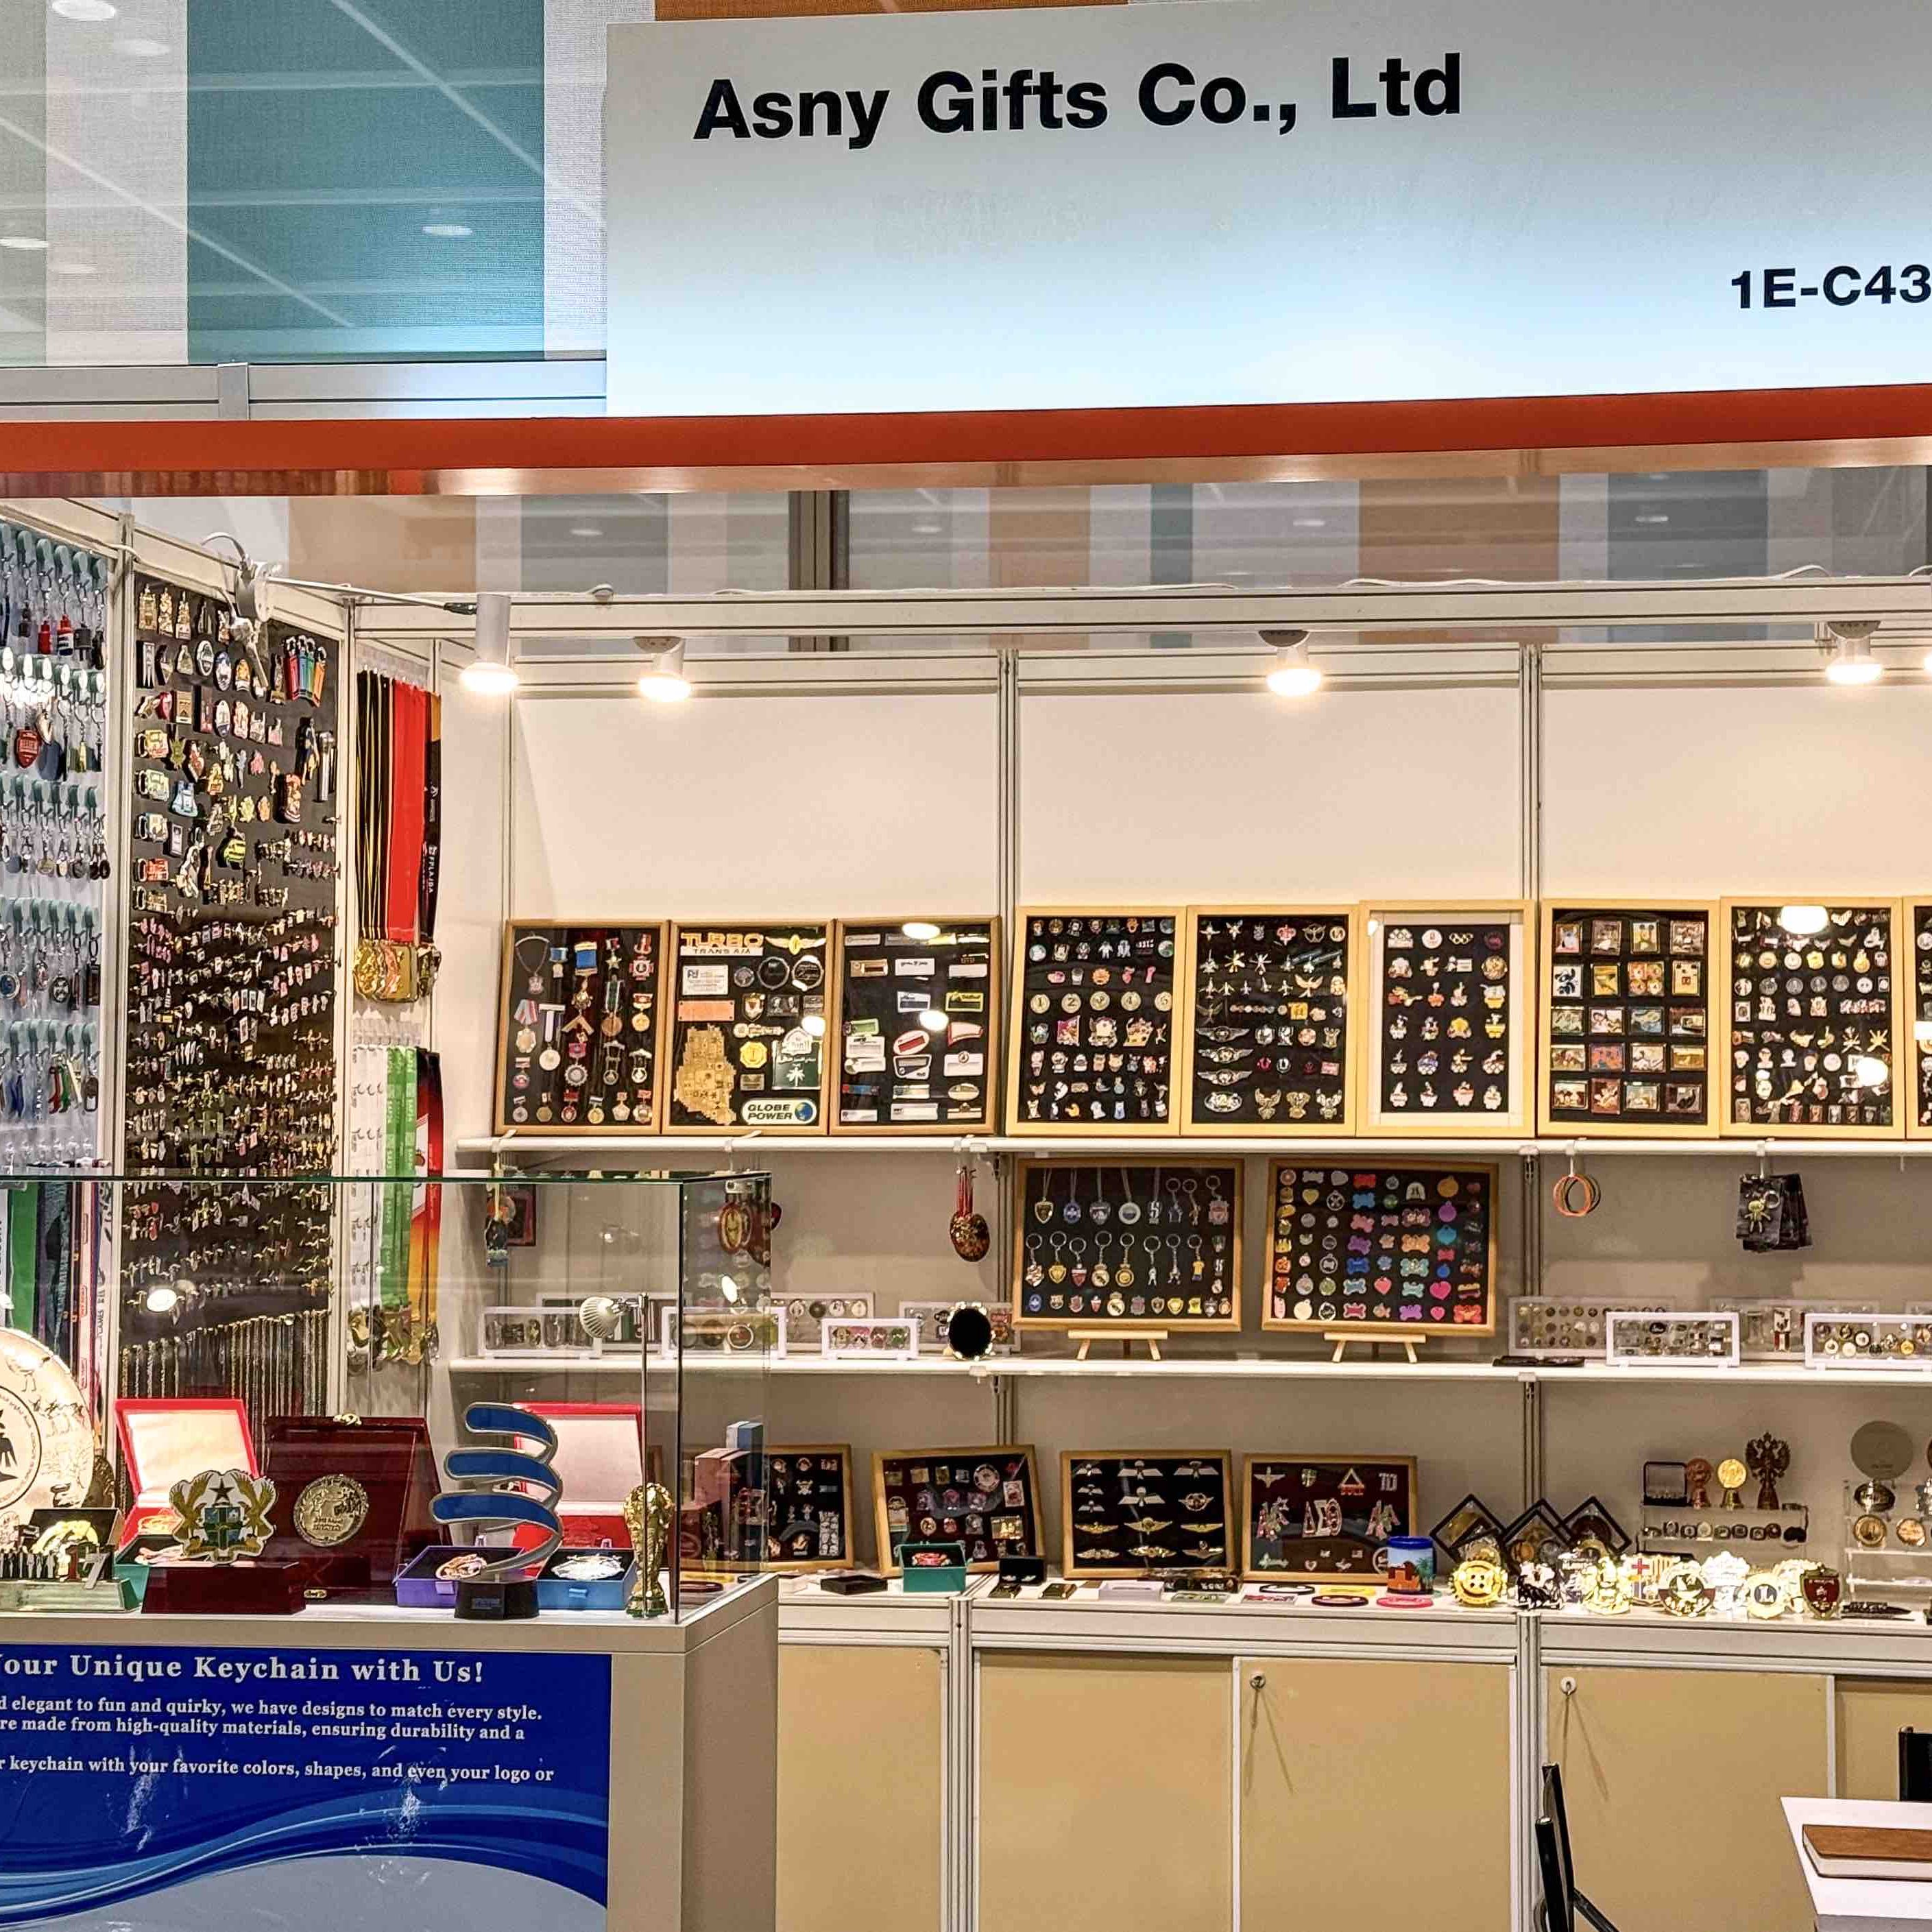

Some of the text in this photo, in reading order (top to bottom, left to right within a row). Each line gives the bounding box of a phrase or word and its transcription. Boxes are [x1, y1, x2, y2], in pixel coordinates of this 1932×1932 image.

[692, 51, 1461, 149] Asny Gifts Co., Ltd
[1730, 264, 1932, 309] 1E-C43
[680, 932, 764, 948] TURBO
[0, 1654, 483, 1683] our Unique Keychain with Us!
[12, 1695, 72, 1714] elegant
[77, 1698, 93, 1711] to
[98, 1697, 126, 1712] fun
[130, 1698, 162, 1713] and
[166, 1698, 226, 1717] quirky,
[231, 1703, 254, 1714] we
[258, 1700, 298, 1715] have
[302, 1700, 365, 1719] designs
[370, 1704, 386, 1717] to
[391, 1703, 442, 1717] match
[447, 1707, 493, 1722] every
[497, 1704, 542, 1723] style.
[21, 1716, 67, 1731] made
[71, 1716, 112, 1732] from
[116, 1717, 219, 1737] high-quality
[222, 1719, 306, 1737] materials,
[311, 1722, 387, 1740] ensuring
[390, 1722, 475, 1742] durability
[479, 1724, 511, 1739] and
[515, 1729, 524, 1740] a
[9, 1755, 84, 1774] keychain
[88, 1756, 125, 1772] with
[129, 1762, 169, 1777] your
[173, 1758, 239, 1774] favorite
[243, 1760, 300, 1778] colors,
[304, 1761, 367, 1780] shapes,
[372, 1763, 403, 1778] and
[407, 1767, 446, 1780] even
[450, 1769, 490, 1784] your
[494, 1764, 531, 1784] logo
[535, 1770, 554, 1781] or
